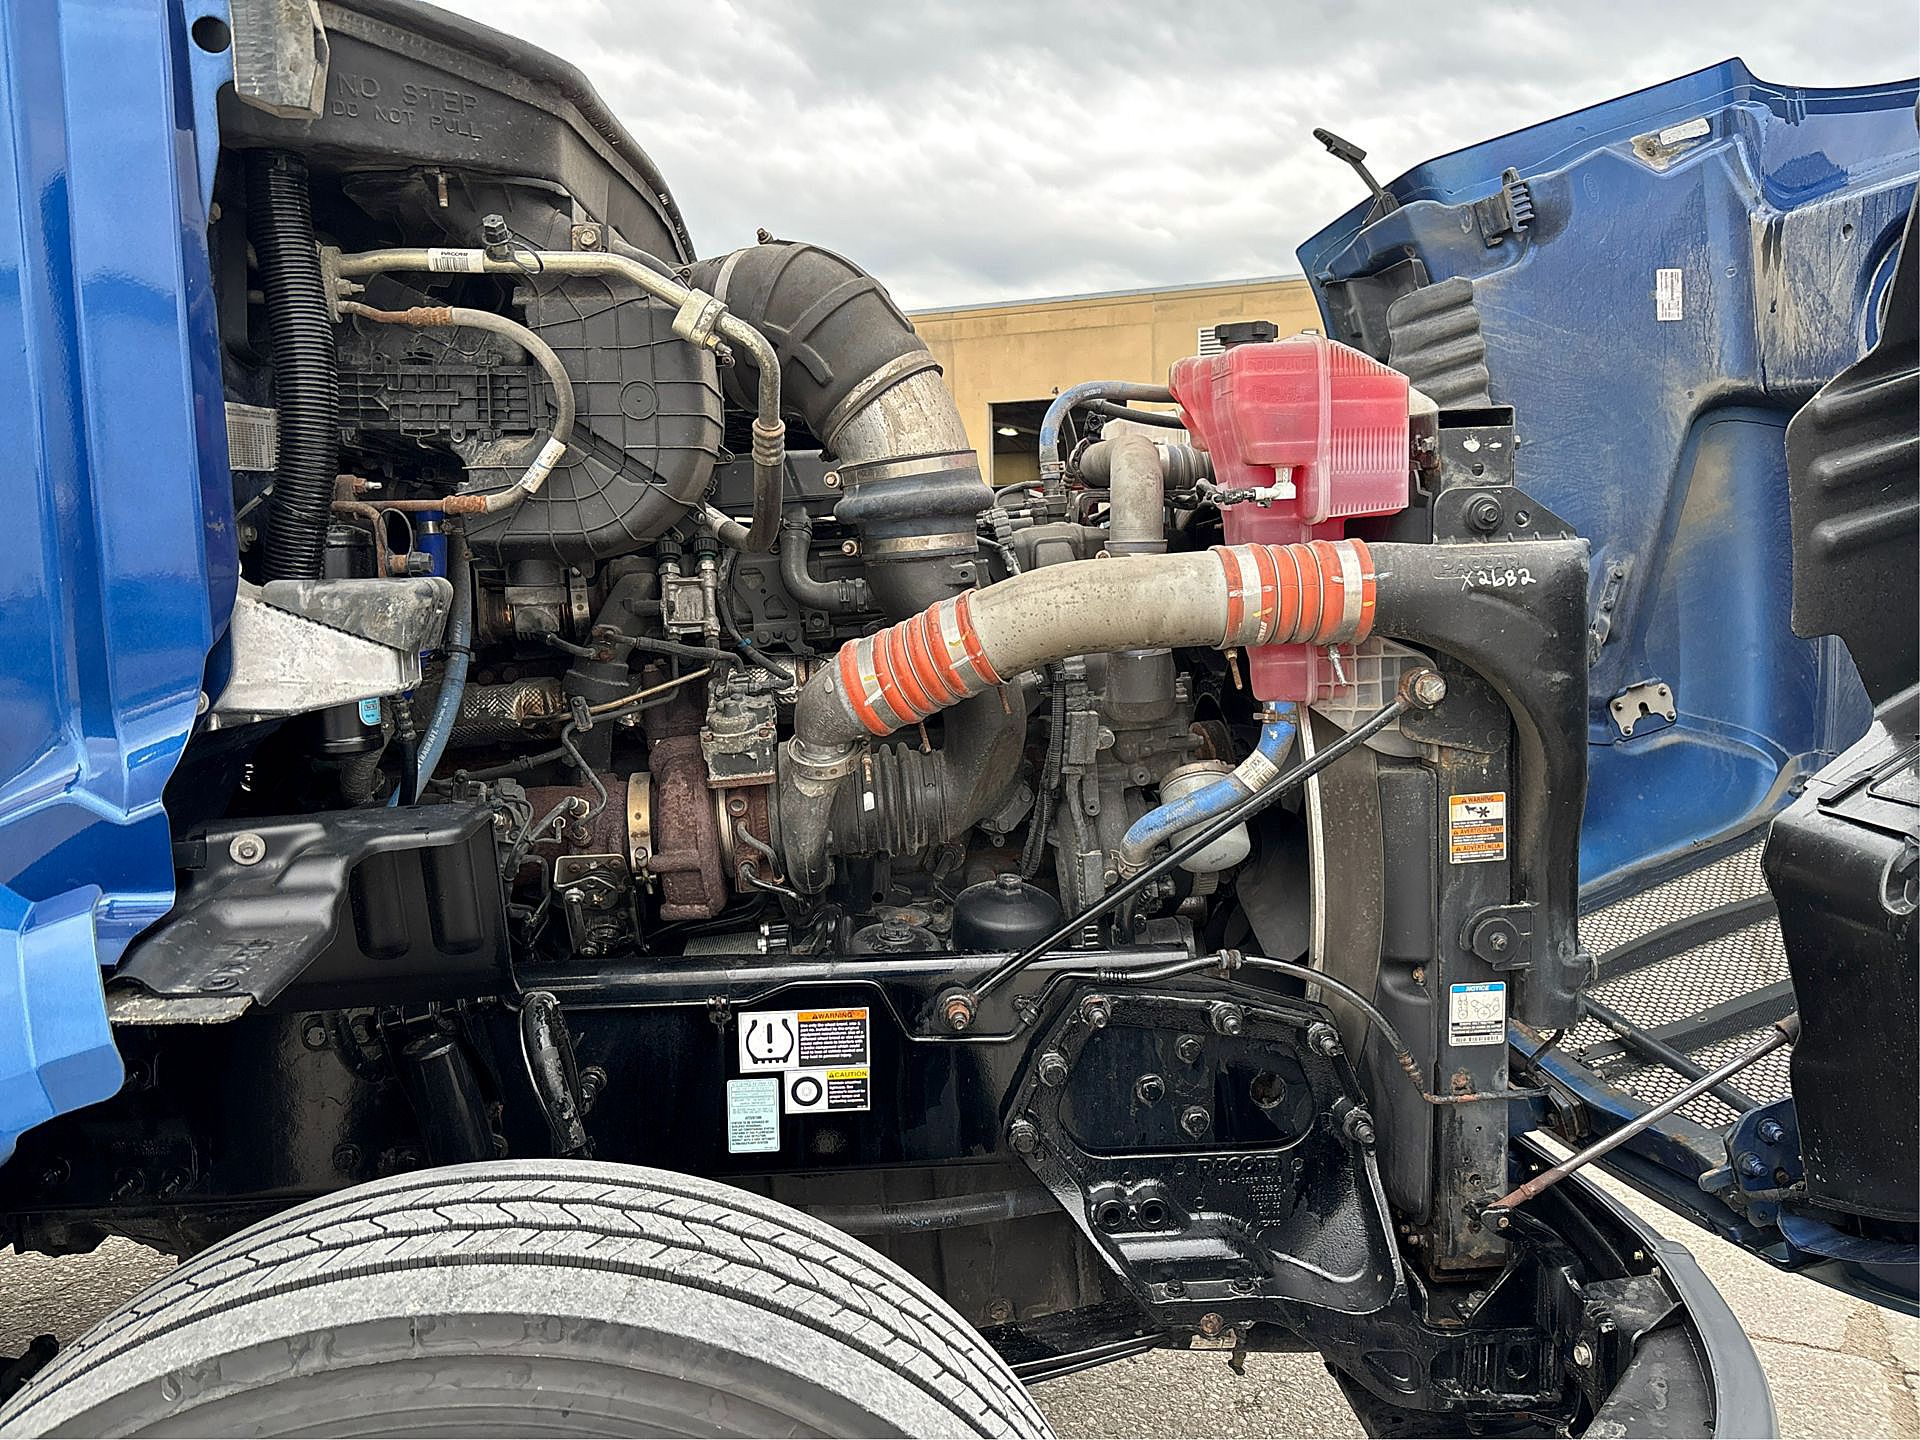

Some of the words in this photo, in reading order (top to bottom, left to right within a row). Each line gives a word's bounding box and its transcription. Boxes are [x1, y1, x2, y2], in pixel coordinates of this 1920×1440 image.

[337, 71, 381, 99] NO
[402, 82, 478, 116] STEP
[331, 100, 359, 118] DO
[375, 104, 415, 127] NOT
[430, 114, 484, 142] PULL
[1461, 567, 1537, 591] X2682
[818, 1011, 853, 1020] WARNING
